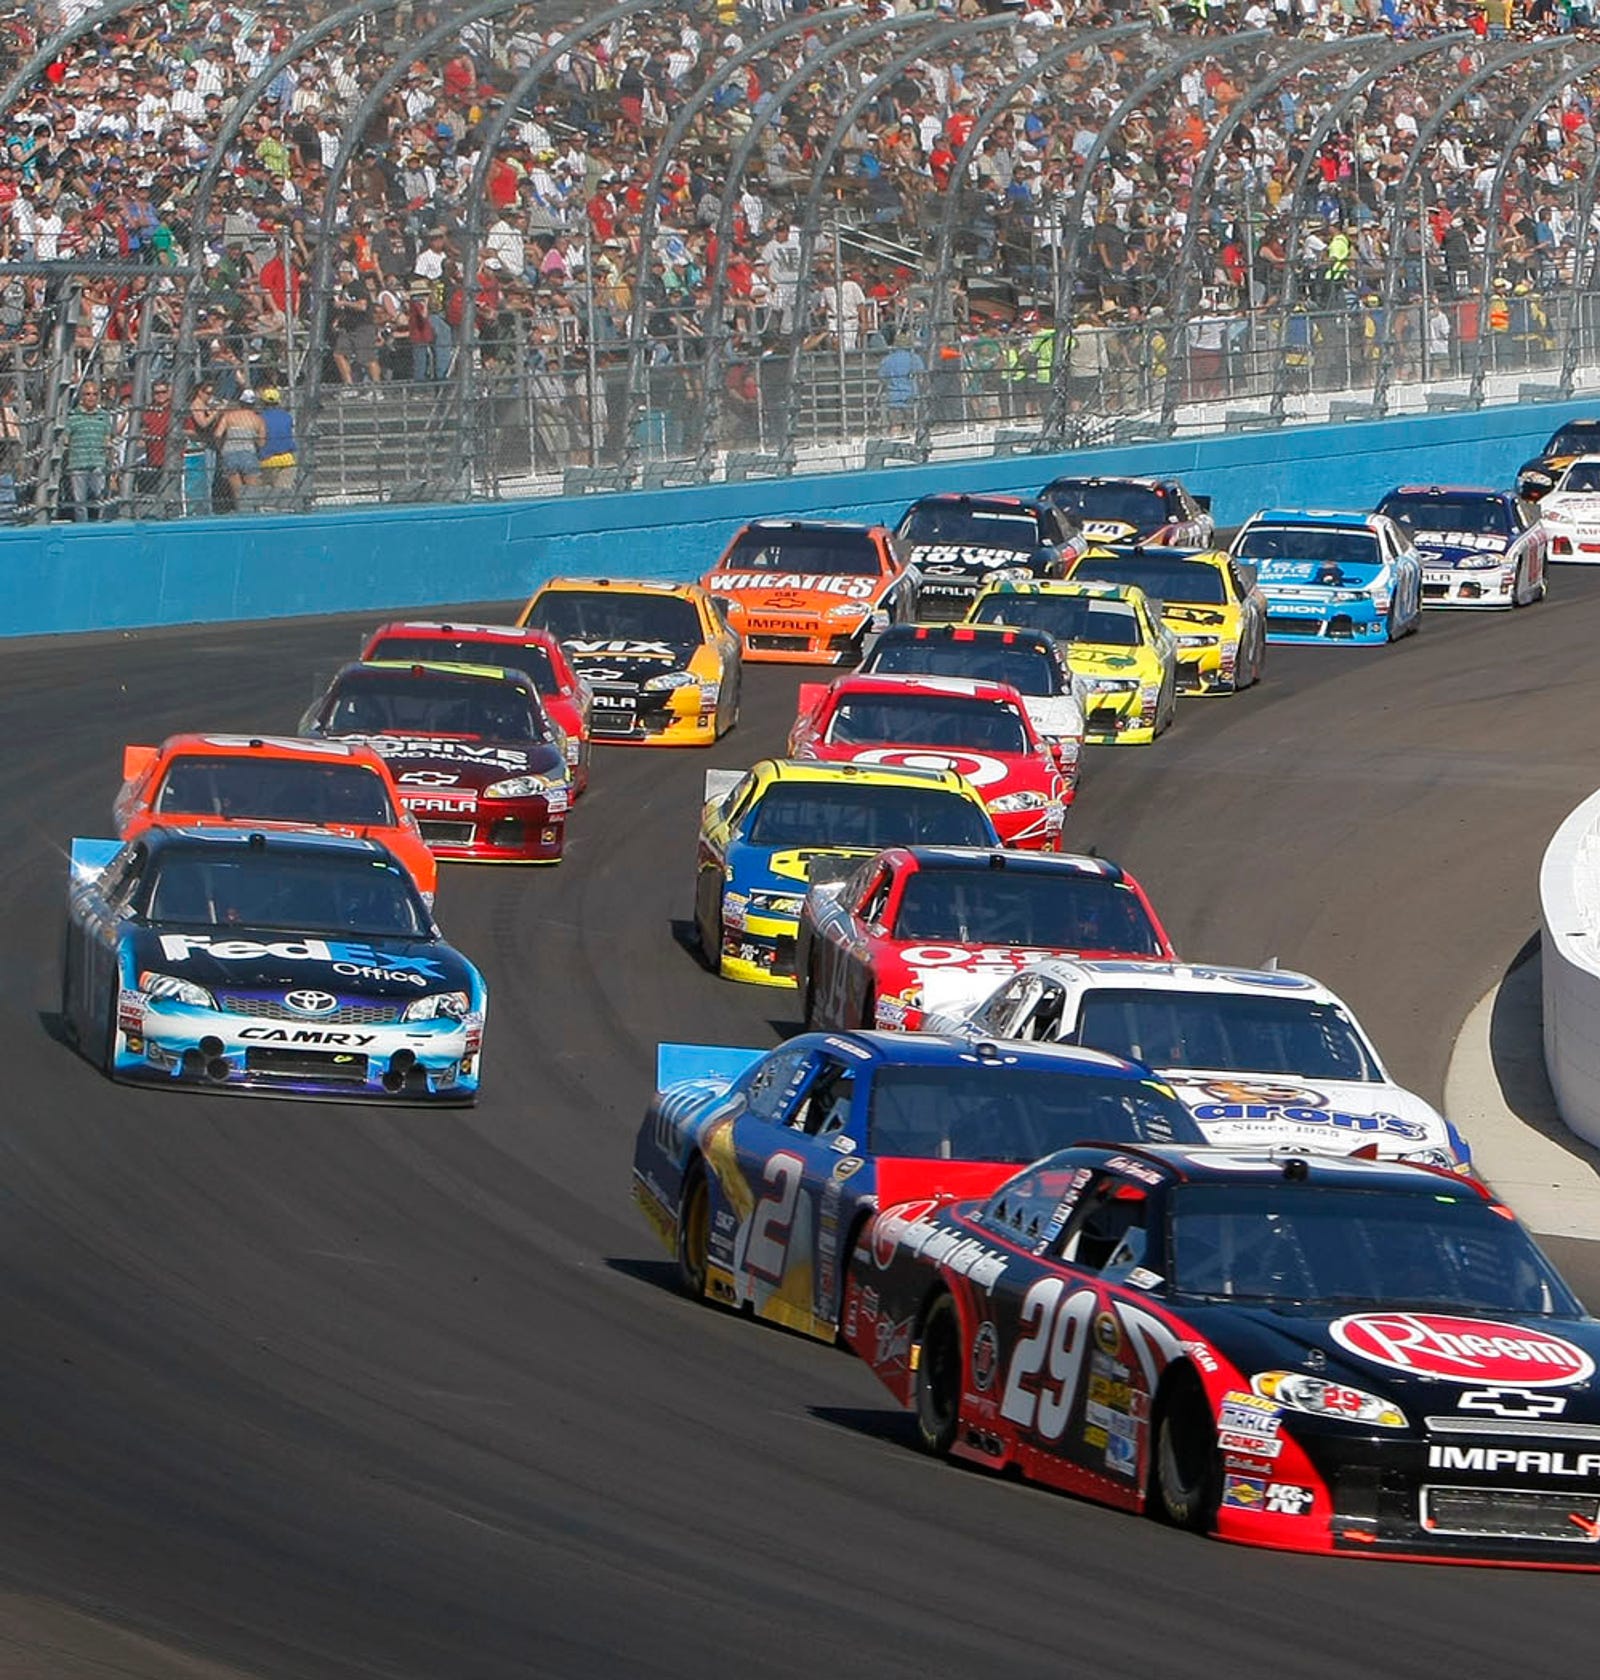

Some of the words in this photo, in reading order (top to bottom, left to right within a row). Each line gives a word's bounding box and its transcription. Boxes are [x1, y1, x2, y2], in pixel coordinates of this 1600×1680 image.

[710, 573, 877, 598] WHEATIES
[747, 618, 819, 630] IMPALA
[593, 696, 637, 708] ALA
[372, 740, 528, 764] DRIVE
[433, 752, 529, 772] HUNGER
[400, 798, 477, 813] MPALA
[159, 934, 446, 980] FedEx
[333, 963, 427, 987] Office
[238, 1027, 378, 1047] CAMRY
[1232, 1122, 1289, 1134] Since
[1296, 1126, 1341, 1138] 1955
[746, 1150, 805, 1279] 2
[1352, 1312, 1573, 1369] Rheem
[1000, 1276, 1099, 1441] 29
[1323, 1387, 1362, 1412] 29
[1222, 1409, 1278, 1433] MAHLE
